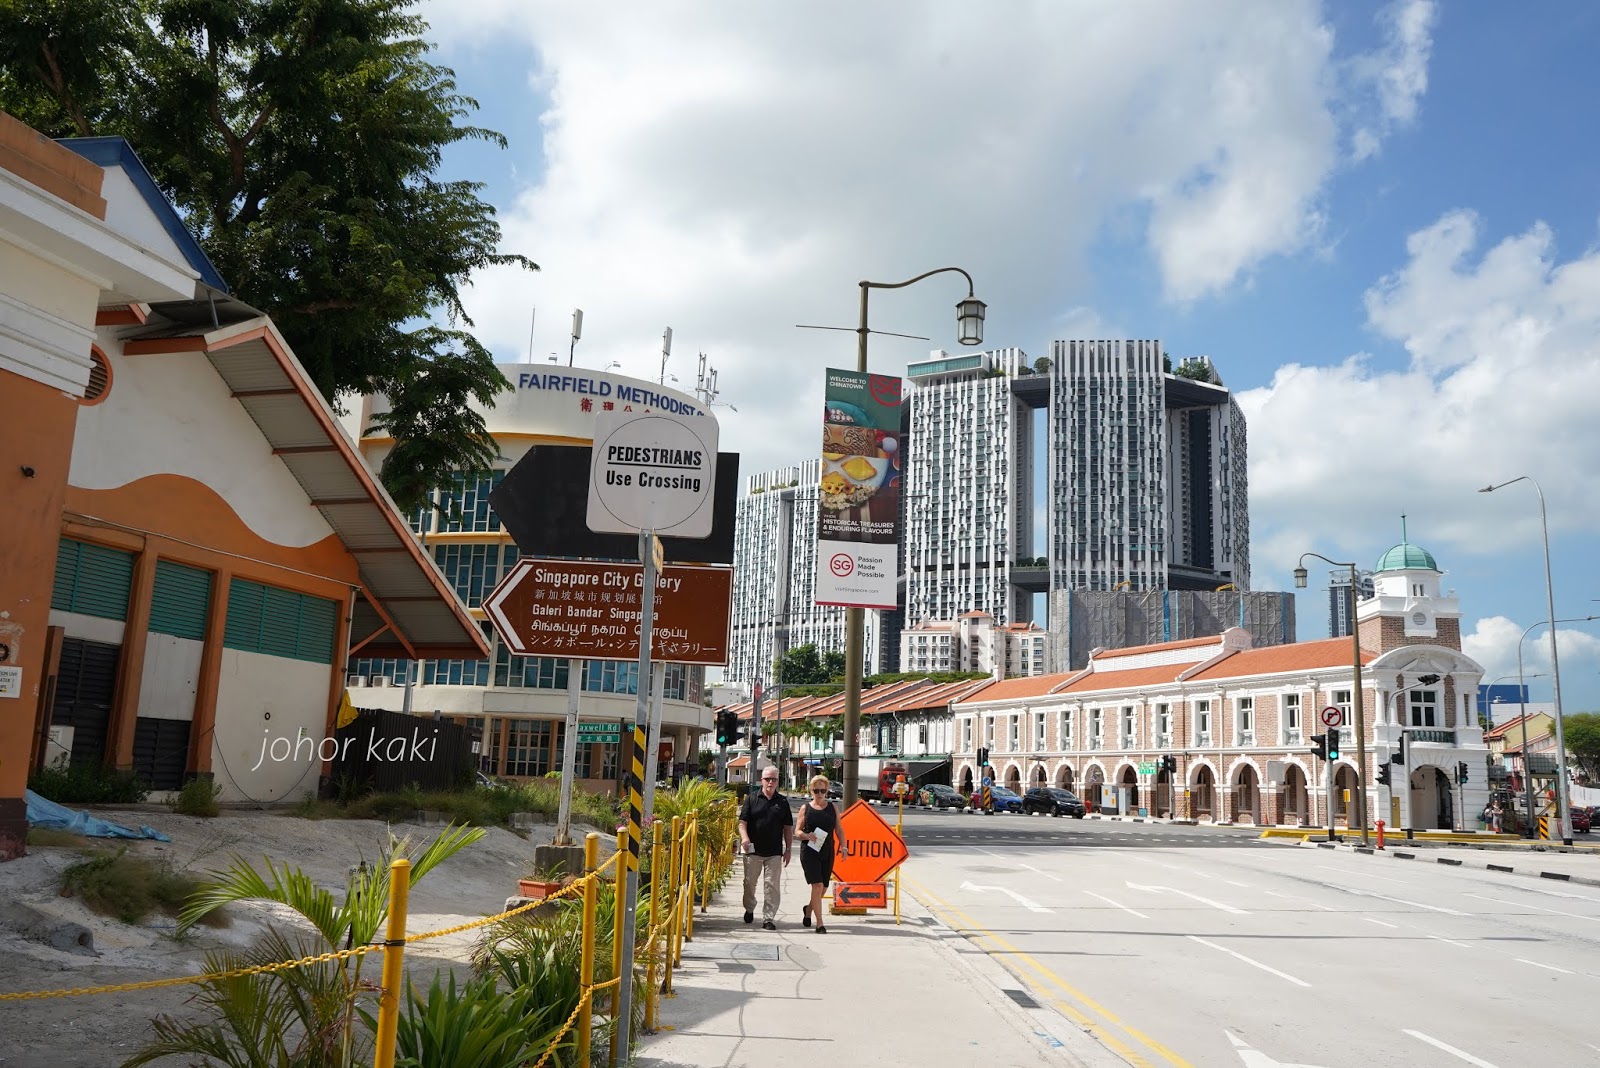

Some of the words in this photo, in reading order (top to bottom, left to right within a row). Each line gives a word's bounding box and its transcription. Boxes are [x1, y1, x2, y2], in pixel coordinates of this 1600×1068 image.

[829, 376, 858, 384] WELCOME
[829, 381, 864, 390] CHINATOWN
[875, 377, 902, 397] SG
[519, 373, 612, 397] FAIRFIELD
[617, 384, 696, 416] METHODIST
[607, 445, 702, 466] PEDESTRIANS
[606, 470, 632, 486] Use
[638, 471, 701, 493] Crossing
[823, 518, 859, 526] HISTORICAL
[859, 520, 895, 529] TREASURES
[828, 524, 861, 533] ENDURING
[861, 526, 893, 535] FLAVOURS
[833, 559, 851, 571] SG
[857, 556, 883, 564] Passion
[535, 568, 599, 588] Singapore
[603, 571, 630, 590] City
[634, 572, 682, 592] Glery
[534, 588, 663, 605] 新加坡城市规划展馆
[532, 603, 562, 616] Galeri
[567, 605, 604, 618] Bandar
[610, 607, 659, 622] Singapa
[579, 723, 605, 731] axwell
[836, 840, 893, 859] AUTION
